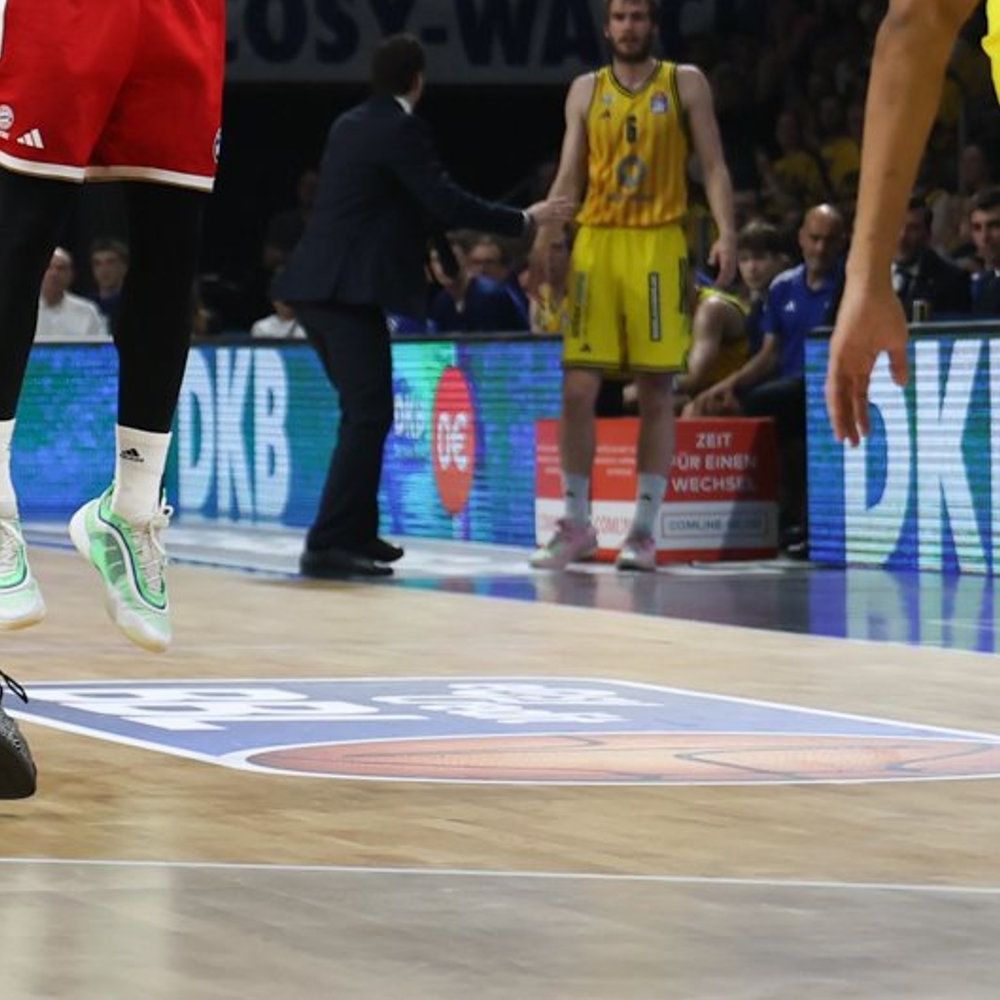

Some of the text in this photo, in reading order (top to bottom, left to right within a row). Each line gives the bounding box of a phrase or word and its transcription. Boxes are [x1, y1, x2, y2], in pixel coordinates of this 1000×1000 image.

[178, 347, 291, 518] DKB
[437, 411, 468, 470] 0€
[696, 432, 732, 449] ZEIT
